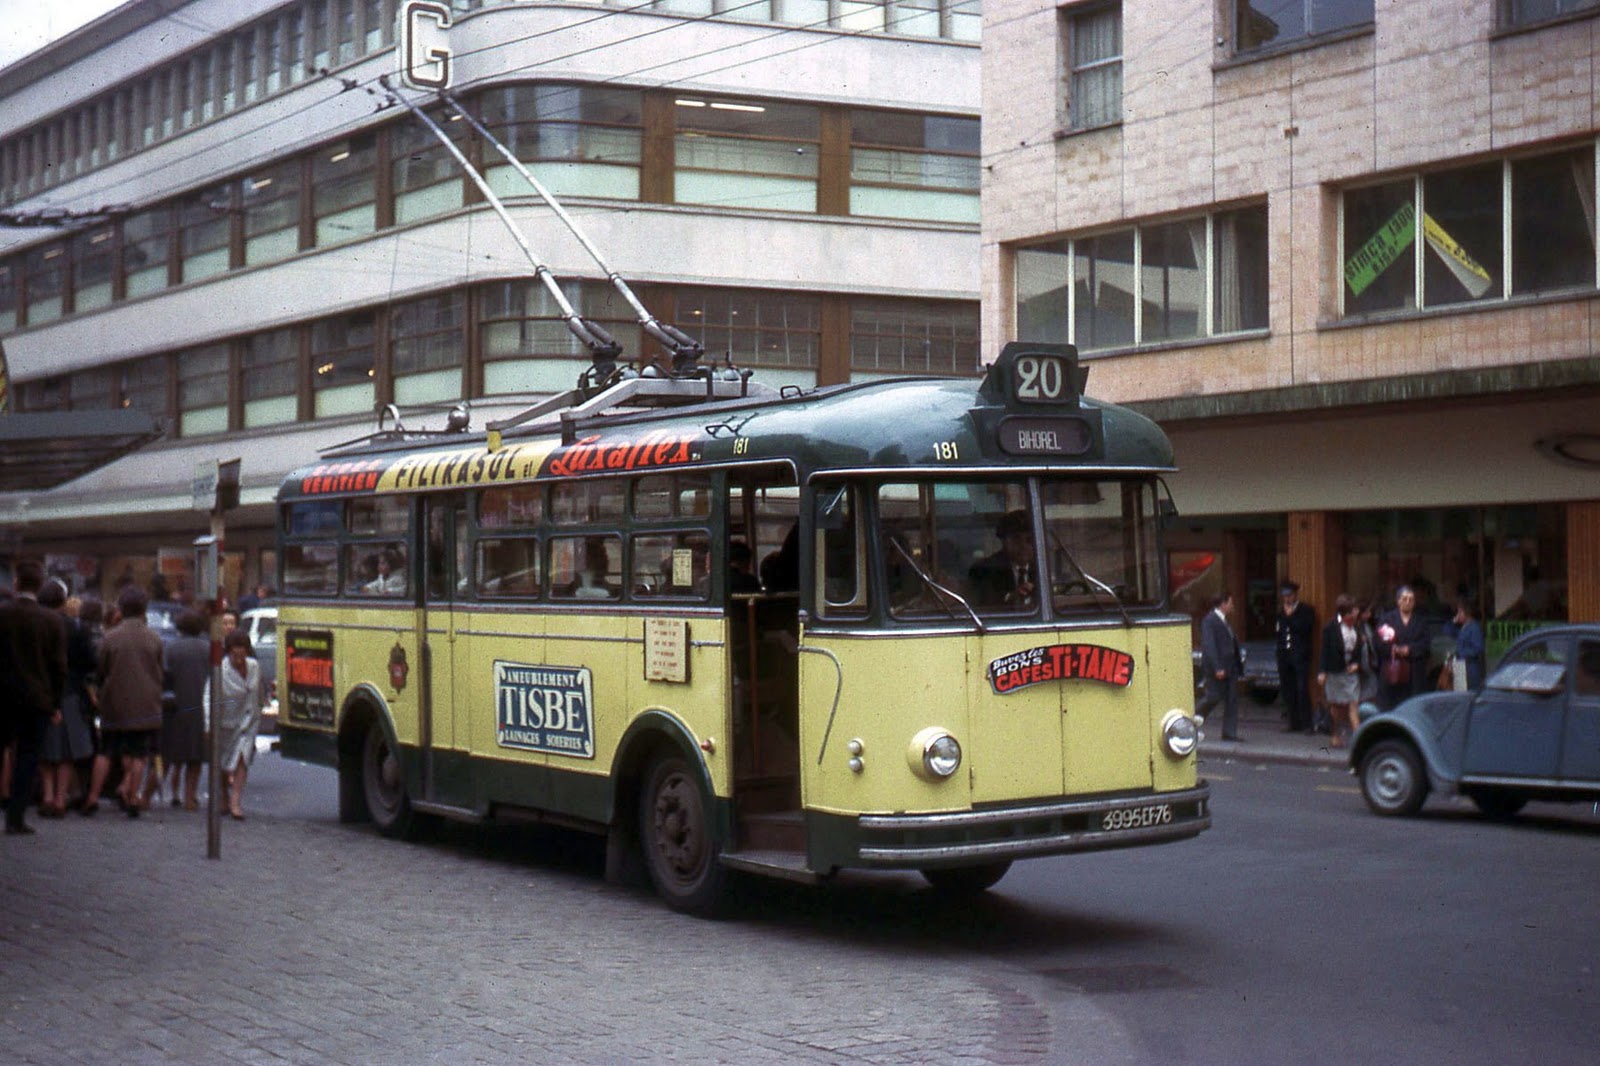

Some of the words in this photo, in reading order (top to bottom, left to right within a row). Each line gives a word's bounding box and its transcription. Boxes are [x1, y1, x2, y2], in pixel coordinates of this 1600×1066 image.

[402, 1, 453, 91] G
[1017, 357, 1062, 398] 20
[733, 437, 749, 454] 181
[1018, 430, 1062, 450] BIHOREL
[550, 428, 700, 476] Luxaflex
[933, 441, 959, 460] 181
[996, 657, 1043, 677] BONS
[507, 671, 576, 687] AMEUBLEMENT
[995, 663, 1053, 692] CAFES
